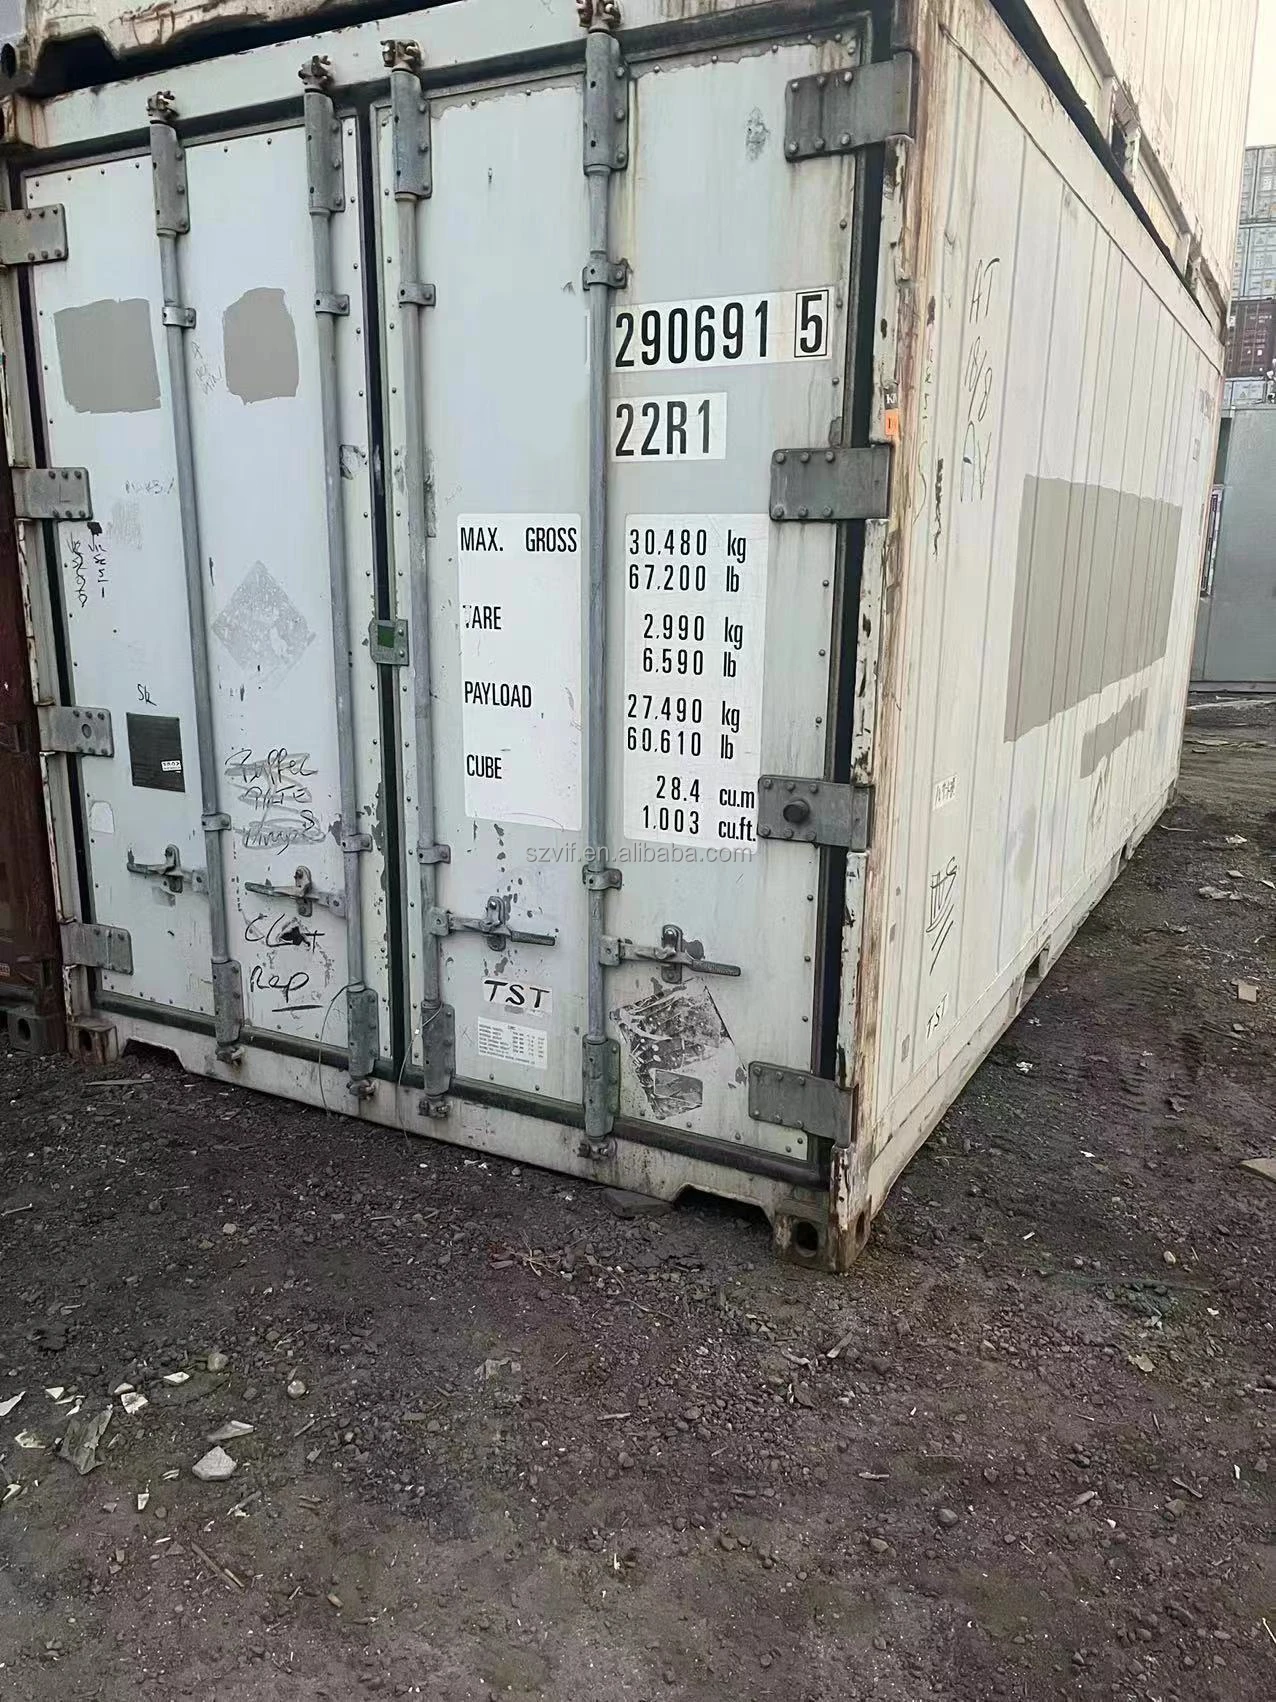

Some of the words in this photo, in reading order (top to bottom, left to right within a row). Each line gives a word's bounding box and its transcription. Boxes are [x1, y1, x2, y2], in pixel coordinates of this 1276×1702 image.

[615, 300, 769, 368] 290691
[799, 294, 823, 353] 5
[615, 399, 710, 457] 22R1
[460, 527, 504, 551] MAX.
[525, 527, 577, 552] GROSS
[727, 529, 747, 563] kg
[726, 565, 740, 592] lb
[724, 616, 743, 650] kg
[723, 651, 737, 677] lb
[464, 681, 532, 708] PAYLOAD
[721, 700, 740, 733] kg
[720, 734, 734, 759] lb
[466, 754, 503, 780] CUBE
[656, 775, 700, 802] 28.4
[719, 788, 755, 809] cu.m
[718, 817, 756, 841] cu.ft.
[484, 979, 550, 1008] TST
